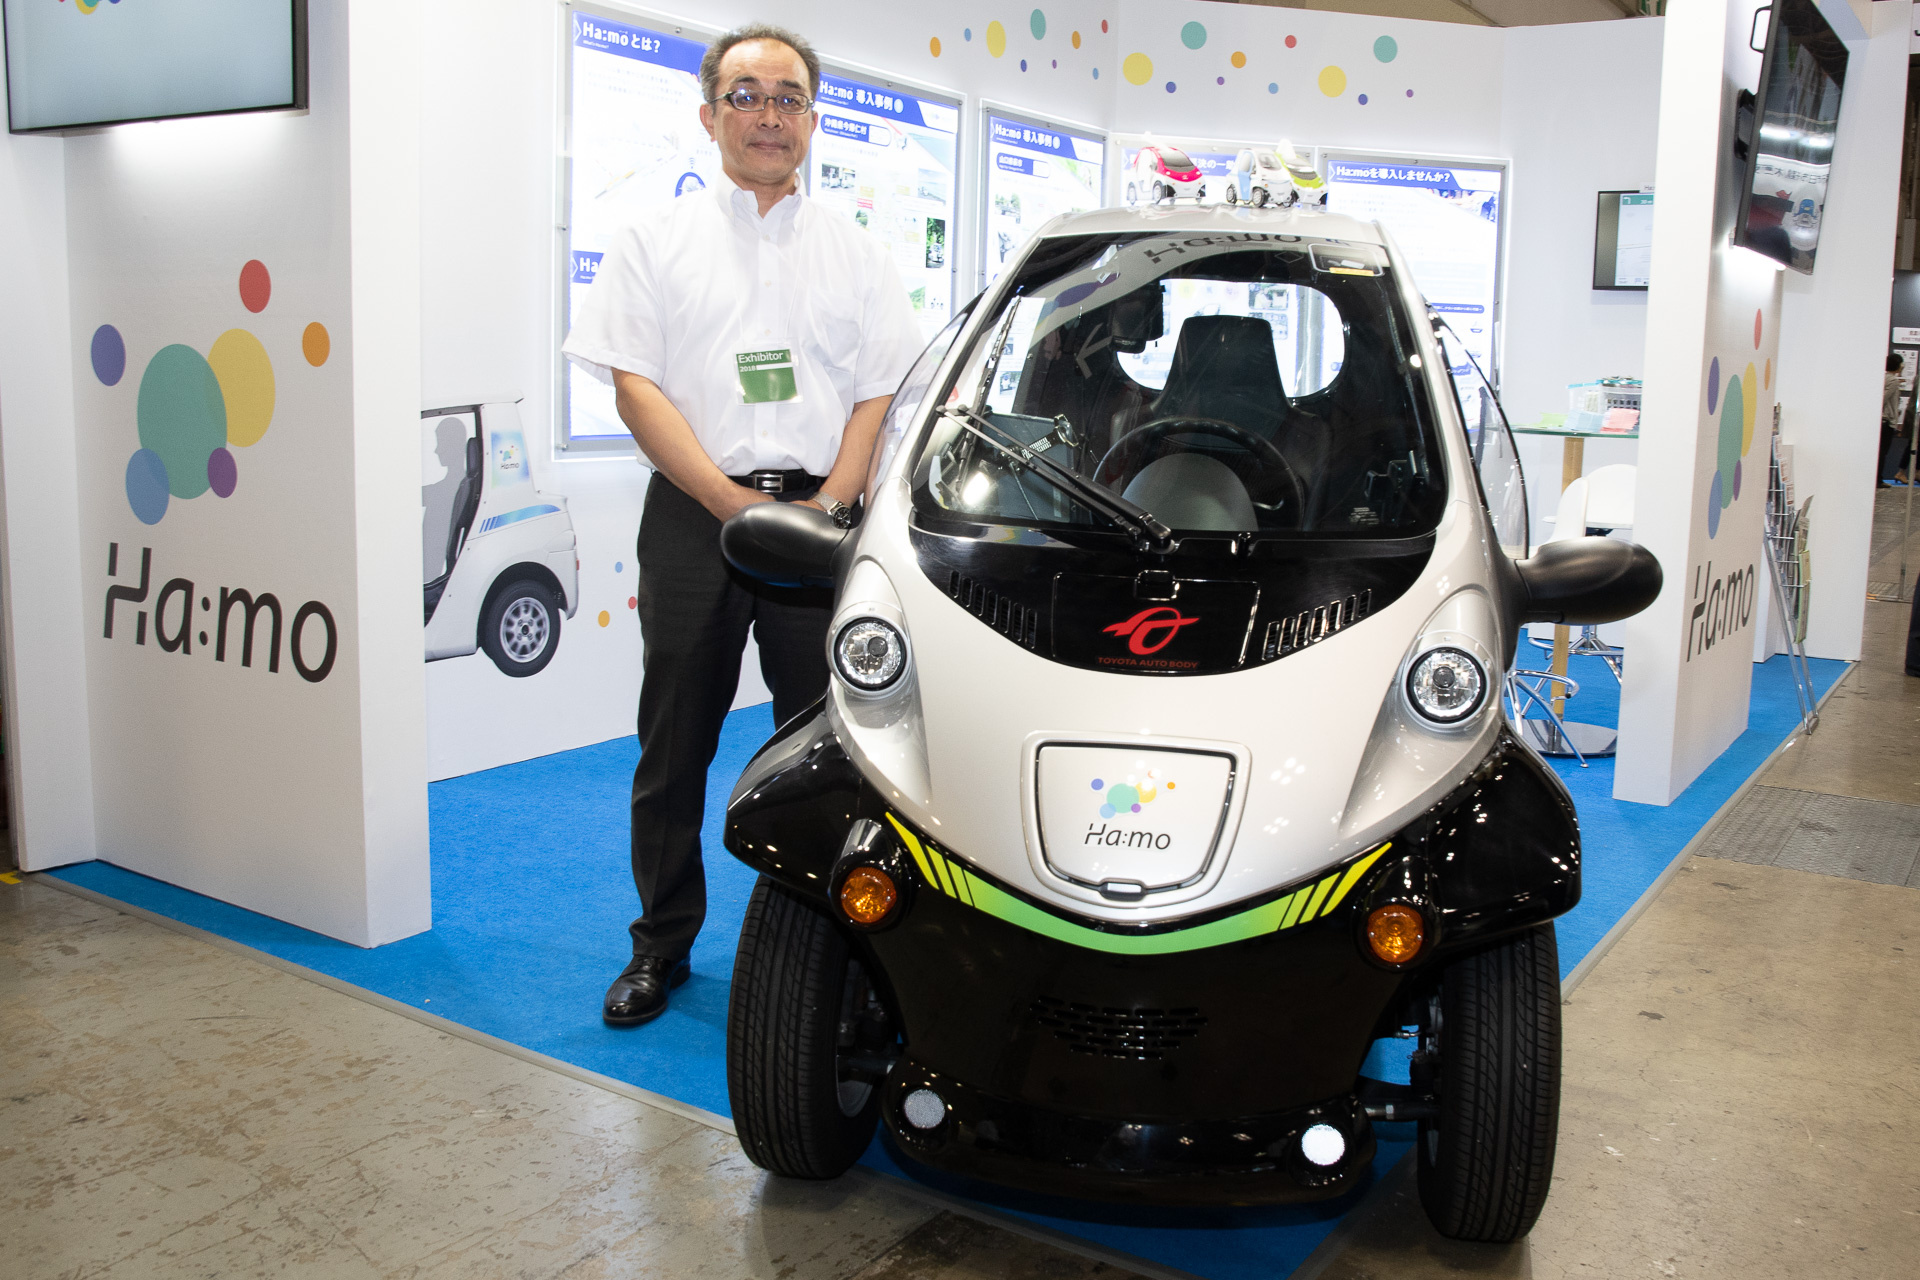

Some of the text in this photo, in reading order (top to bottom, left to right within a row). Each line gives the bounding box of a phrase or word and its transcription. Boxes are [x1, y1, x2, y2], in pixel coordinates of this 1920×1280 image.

[630, 34, 661, 53] とは?
[738, 352, 784, 363] Exhibitor
[739, 365, 756, 373] 2018
[103, 542, 338, 683] Ha:mo
[1686, 560, 1754, 662] Ha:mo
[1098, 656, 1198, 669] TOYOTA AUTO BODY
[1084, 823, 1171, 850] Ha:mo
